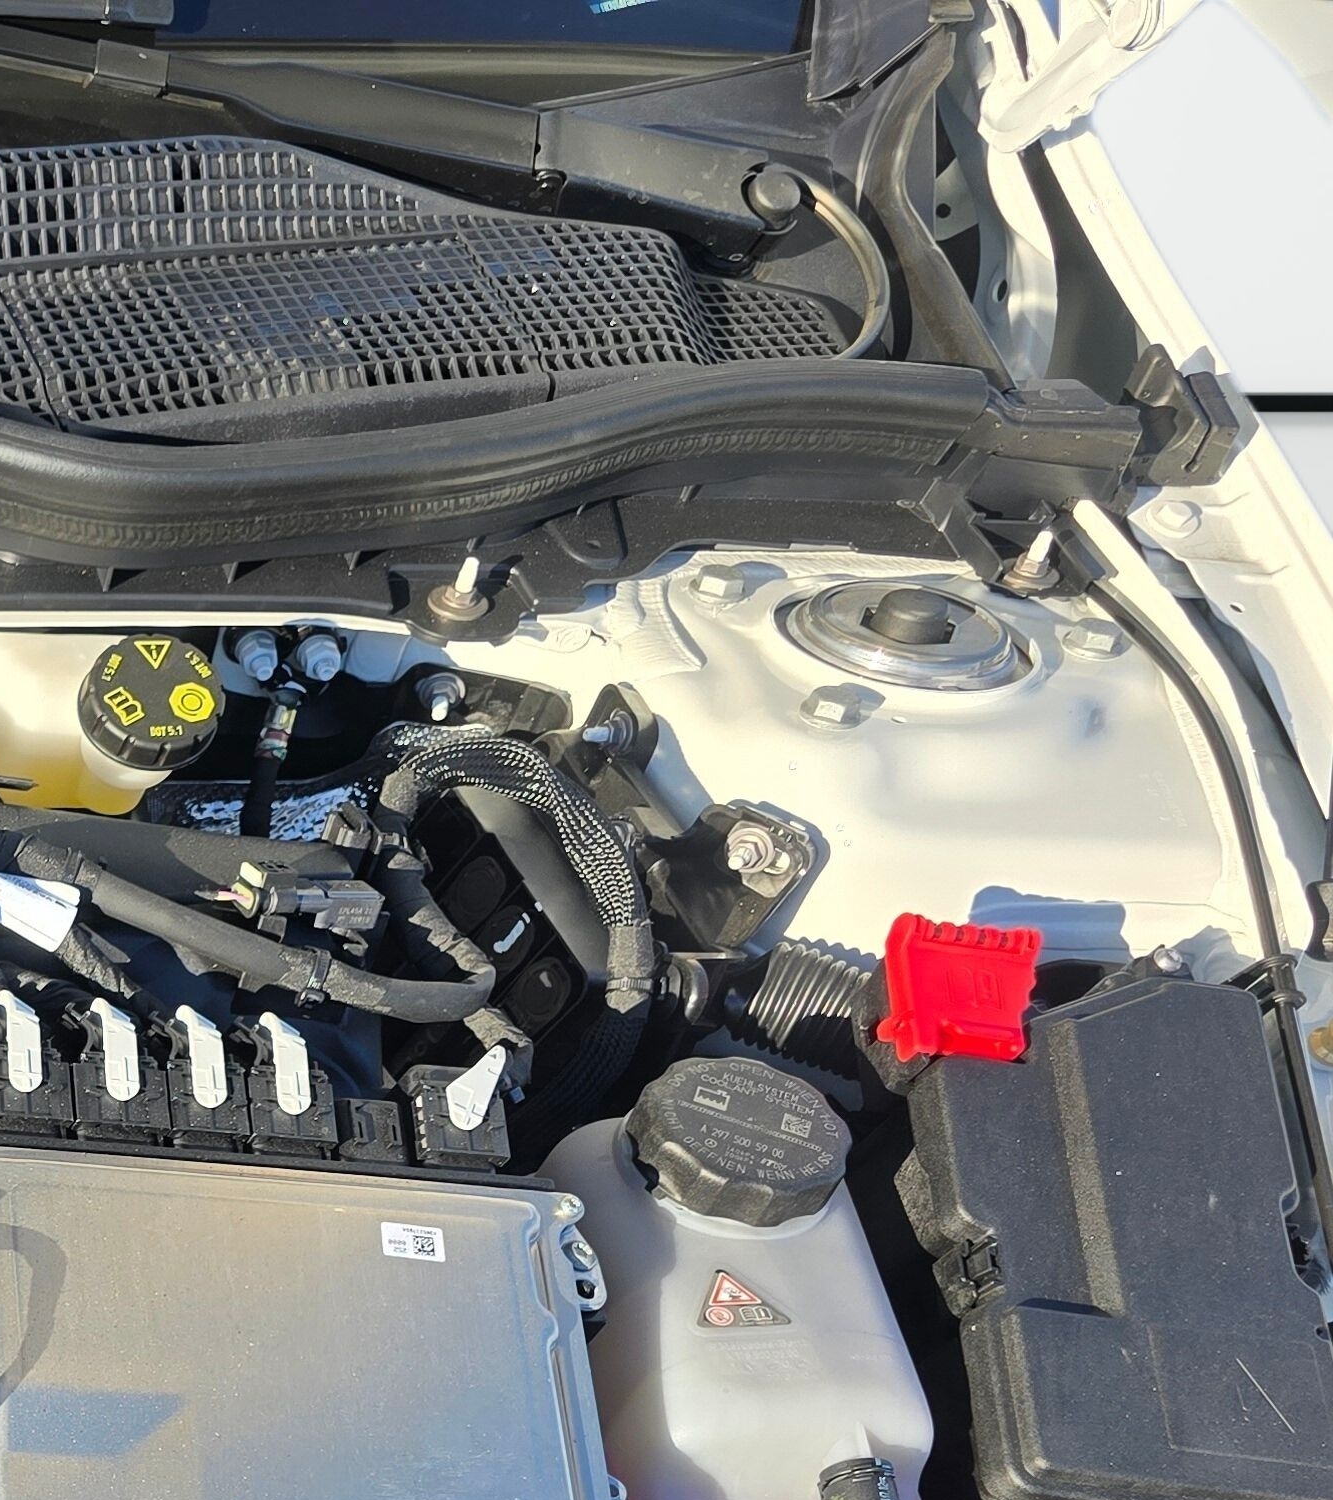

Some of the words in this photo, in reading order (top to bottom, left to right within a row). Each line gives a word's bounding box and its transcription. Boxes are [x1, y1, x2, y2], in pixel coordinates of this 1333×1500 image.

[149, 726, 167, 737] DOT
[167, 725, 184, 736] 5.1
[666, 1073, 686, 1088] DO
[689, 1061, 718, 1075] NOT
[729, 1062, 776, 1080] OPEN
[784, 1079, 823, 1110] WHEN
[819, 1113, 839, 1140] HOT
[700, 1074, 758, 1097] COOLANT
[764, 1094, 816, 1117] SYSTEM
[660, 1099, 684, 1132] NICHT
[683, 1135, 747, 1175] OEFFNEN
[757, 1168, 795, 1181] WENN
[800, 1149, 834, 1178] HEISS
[700, 1124, 707, 1134] A
[711, 1128, 730, 1141] 297
[733, 1135, 752, 1148] 500
[755, 1142, 769, 1153] 59
[771, 1148, 785, 1160] 00
